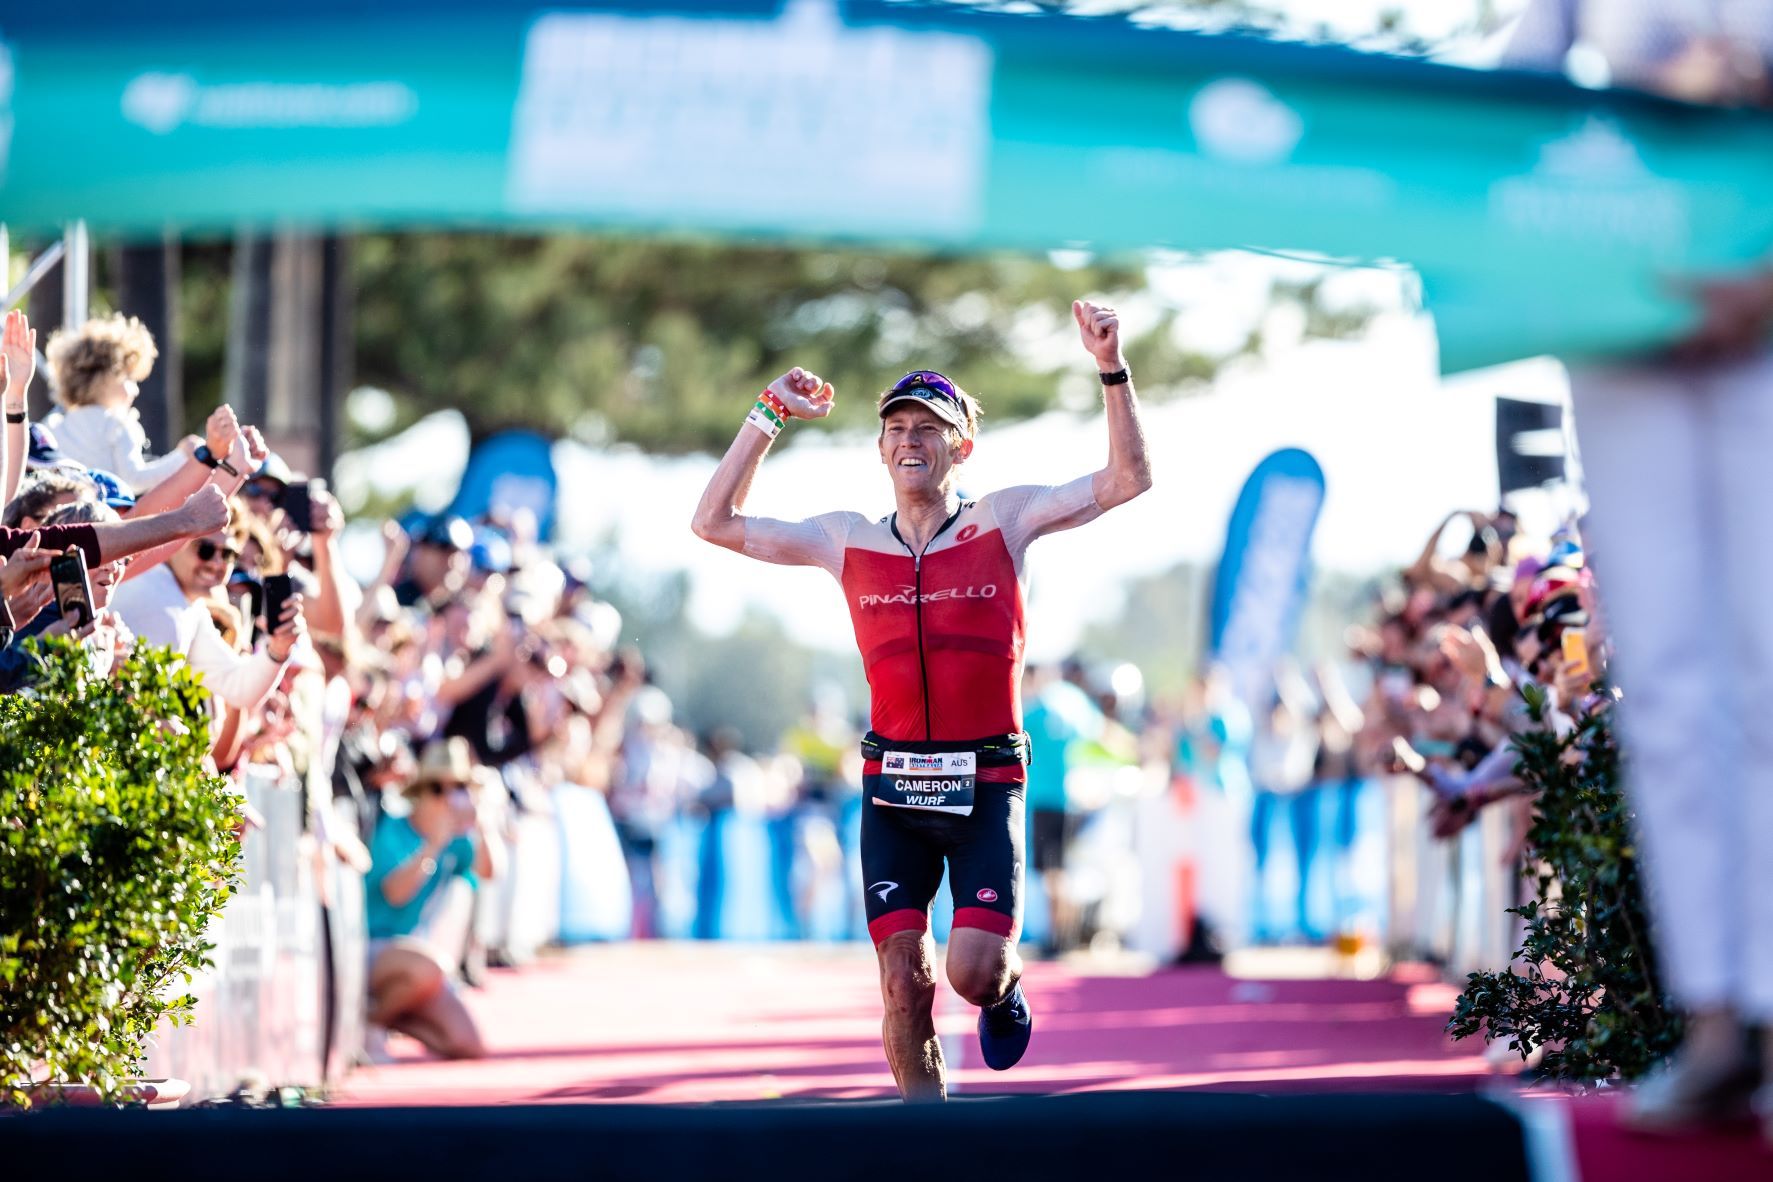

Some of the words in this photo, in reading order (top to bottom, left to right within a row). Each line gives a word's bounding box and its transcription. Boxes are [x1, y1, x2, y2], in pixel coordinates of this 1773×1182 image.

[859, 584, 997, 609] PINARELLO
[951, 759, 968, 767] AUS
[895, 779, 961, 792] CAMERON
[906, 795, 946, 806] WURF
